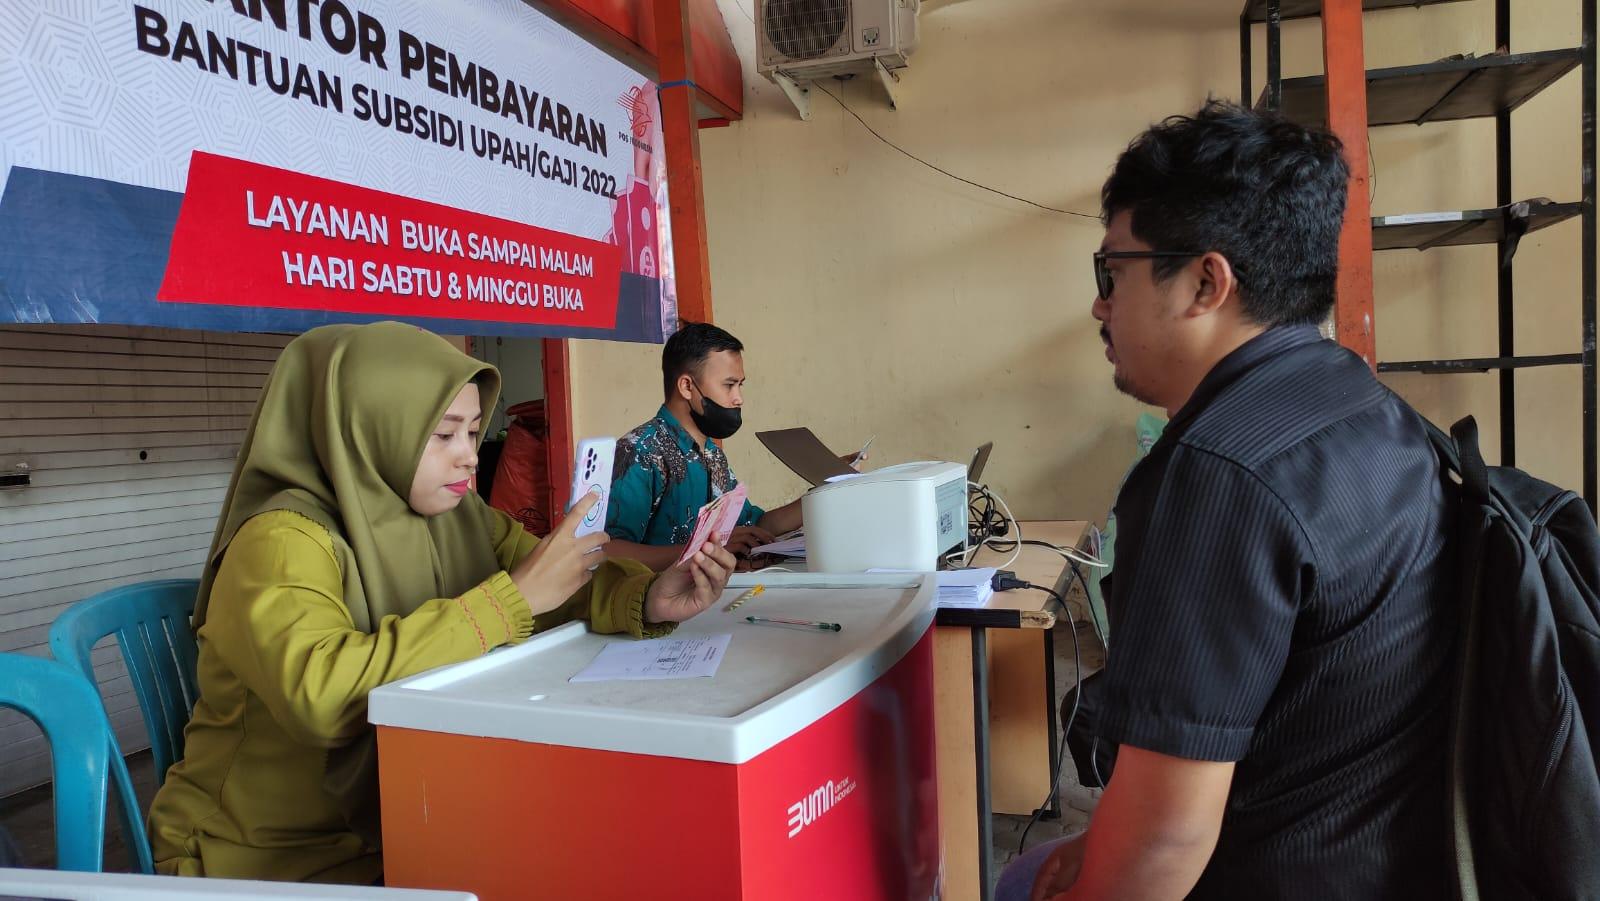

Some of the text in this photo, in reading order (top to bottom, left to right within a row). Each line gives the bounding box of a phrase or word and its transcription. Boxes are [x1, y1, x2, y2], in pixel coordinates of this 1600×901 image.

[134, 4, 618, 200] BANTUAN SUBSIDI UPAH/GAJI 2022
[398, 28, 608, 158] PEMBAYARAN
[246, 190, 389, 246] LAYANAN
[400, 219, 465, 258] BUKA
[467, 232, 537, 269] SAMPAI
[540, 247, 594, 278] MALAM
[281, 250, 584, 311] HARI SABTU & MINGGU BUKA
